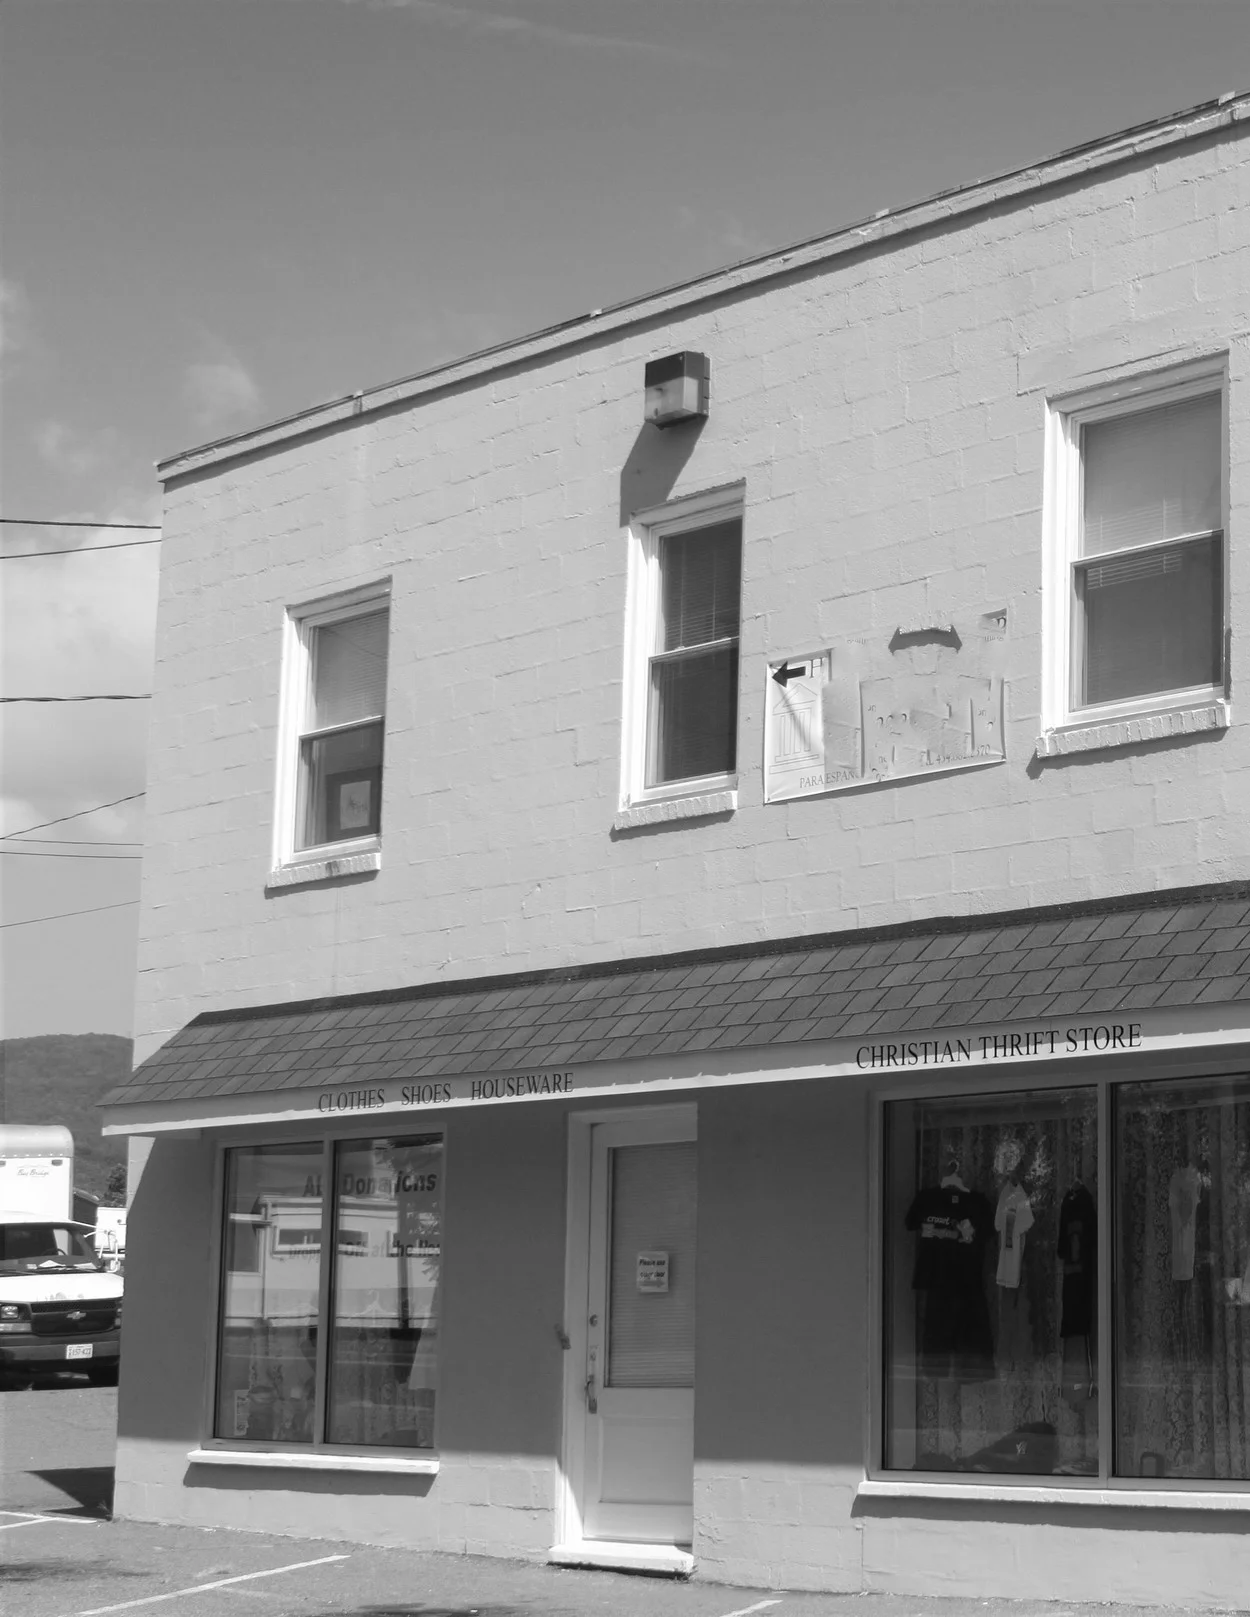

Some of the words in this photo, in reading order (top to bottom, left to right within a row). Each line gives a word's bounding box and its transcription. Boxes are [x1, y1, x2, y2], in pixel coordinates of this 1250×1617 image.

[856, 1038, 972, 1069] CHRISTIAN
[979, 1030, 1060, 1059] THRIFT
[1065, 1023, 1142, 1052] STORE
[318, 1088, 385, 1113] CLOTHES
[401, 1082, 452, 1106] SHOES
[471, 1072, 574, 1101] HOUSEWARE
